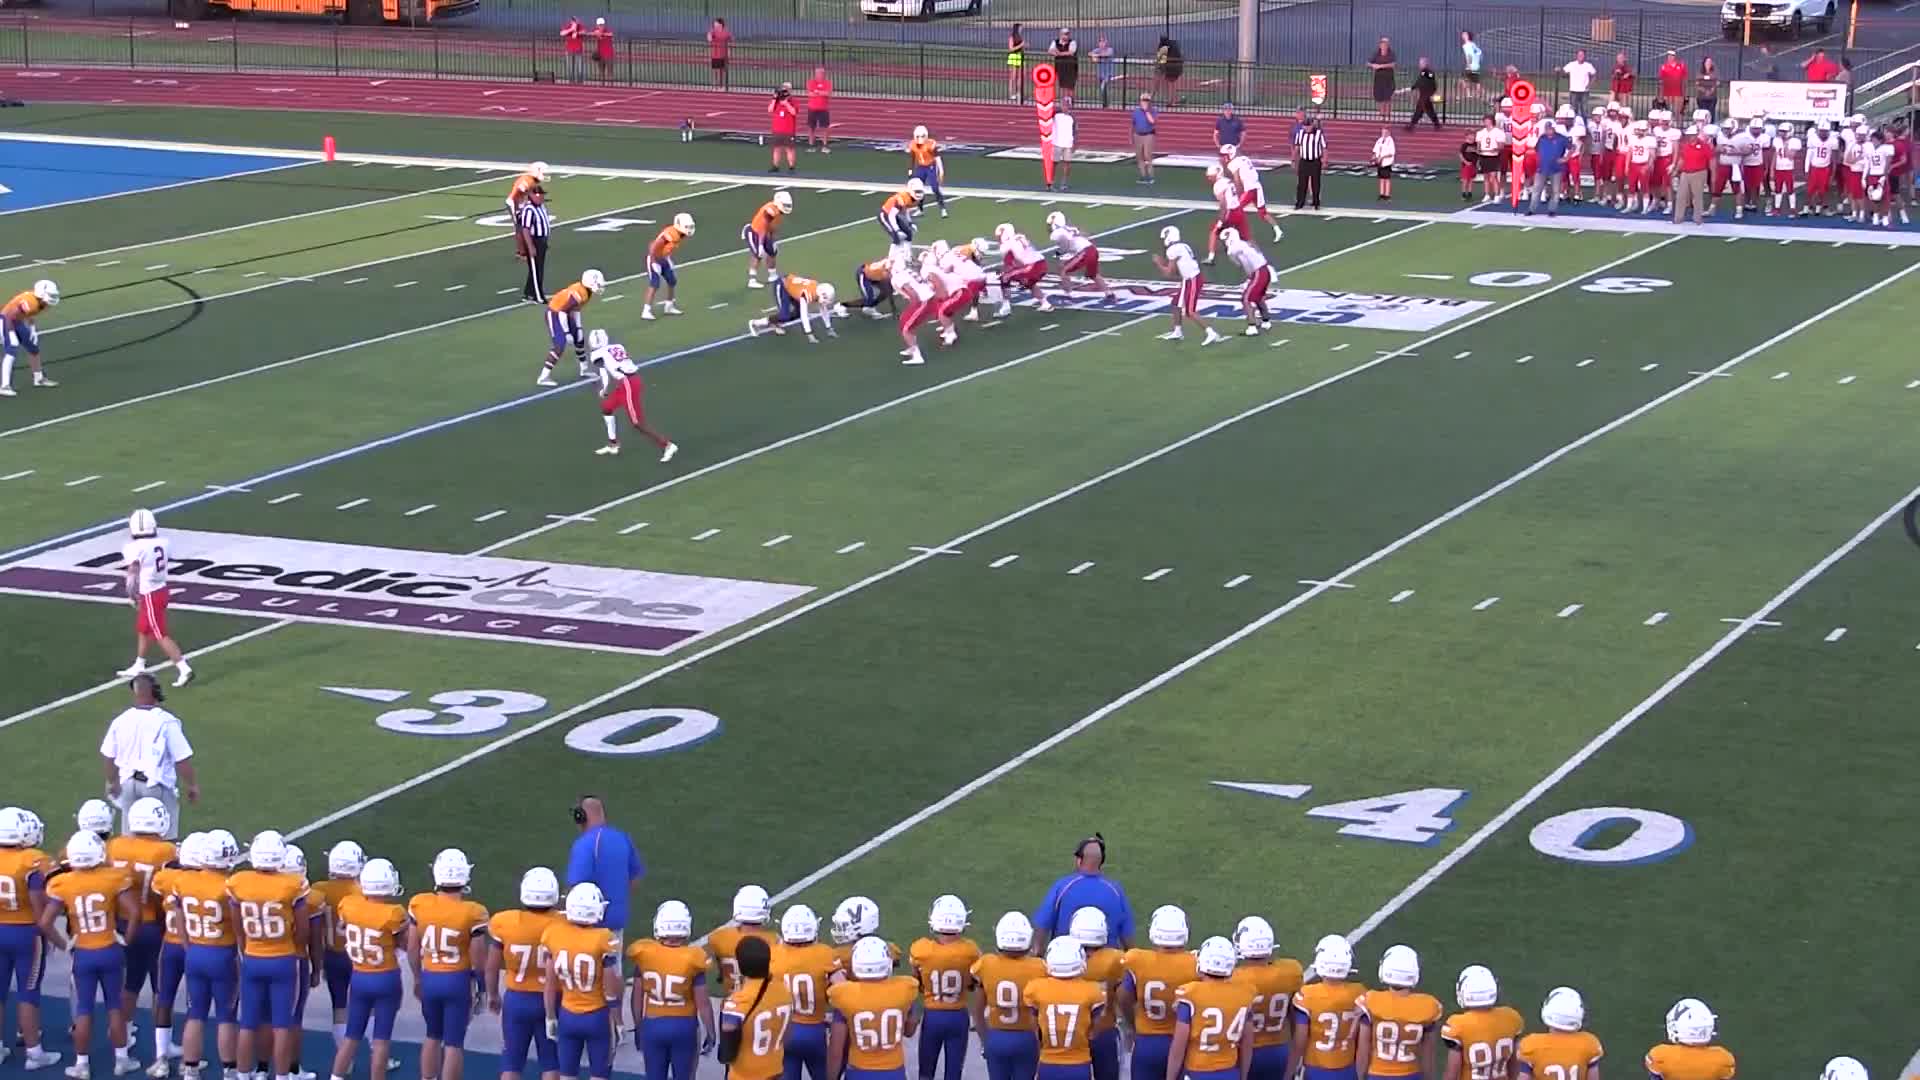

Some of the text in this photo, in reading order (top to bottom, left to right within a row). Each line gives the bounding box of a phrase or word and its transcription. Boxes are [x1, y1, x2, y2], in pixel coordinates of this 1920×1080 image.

[152, 546, 165, 573] 2
[82, 581, 579, 635] ABULANCE
[74, 892, 108, 934] 16
[182, 896, 224, 939] 62
[240, 901, 286, 939] 86
[344, 923, 385, 966] 85
[420, 924, 462, 965] 45
[553, 949, 596, 993] 40
[642, 970, 687, 1007] 35
[996, 979, 1019, 1025] 9
[753, 1003, 792, 1056] 67
[853, 1007, 904, 1051] 60
[1046, 1003, 1080, 1048] 17
[1199, 1006, 1249, 1052] 24
[1375, 1020, 1425, 1063] 82
